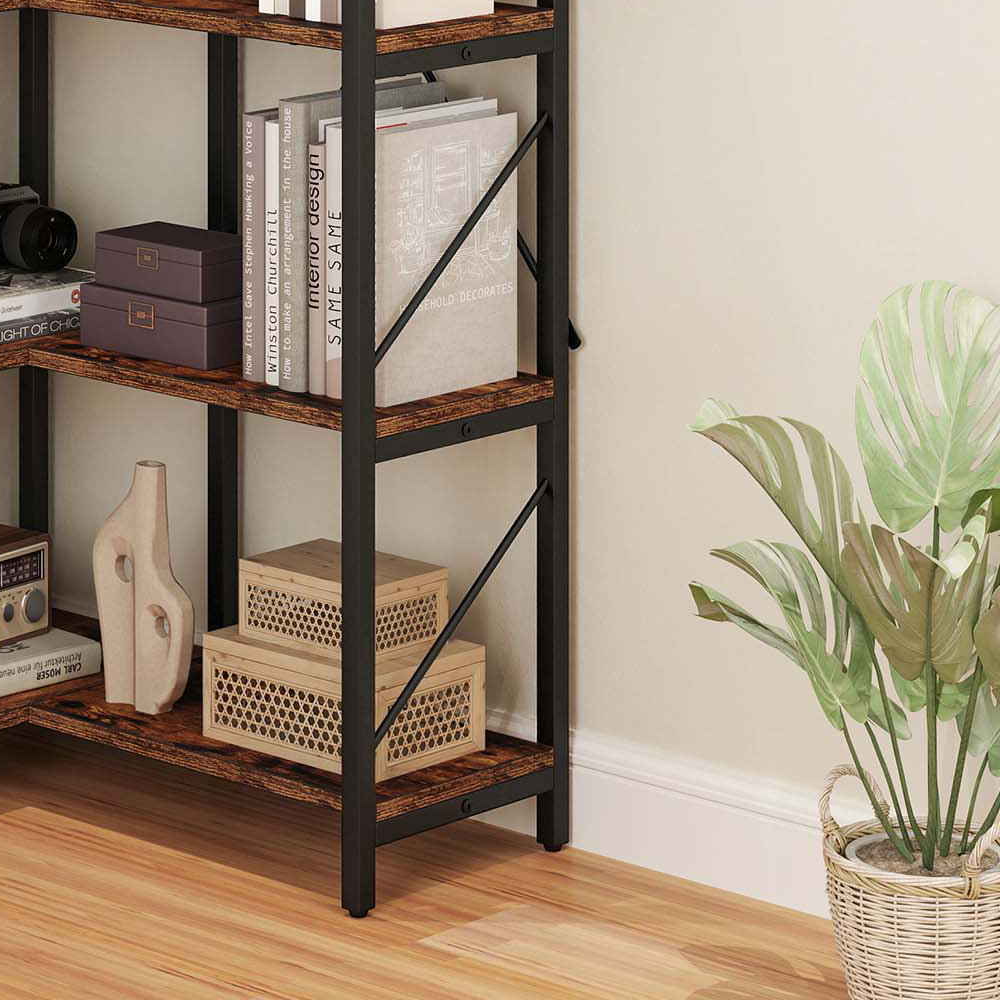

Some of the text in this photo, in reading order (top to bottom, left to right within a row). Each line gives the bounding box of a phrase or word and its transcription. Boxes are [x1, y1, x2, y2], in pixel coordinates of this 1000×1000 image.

[245, 120, 253, 154] Voice
[245, 174, 254, 221] Hawking
[282, 108, 294, 380] How to make an arrangement in the house
[308, 154, 324, 310] Interior design
[245, 228, 254, 274] Stephen
[267, 209, 277, 373] Winston Churchill
[328, 210, 342, 345] SAME SAME
[400, 282, 514, 312] HSEHOLD DECORATES
[30, 322, 48, 336] OF
[49, 316, 80, 331] CHIC
[0, 669, 16, 678] neue
[17, 664, 32, 673] eine
[33, 662, 44, 671] für
[36, 662, 82, 680] CARL MOSER
[44, 652, 82, 667] Architektur
